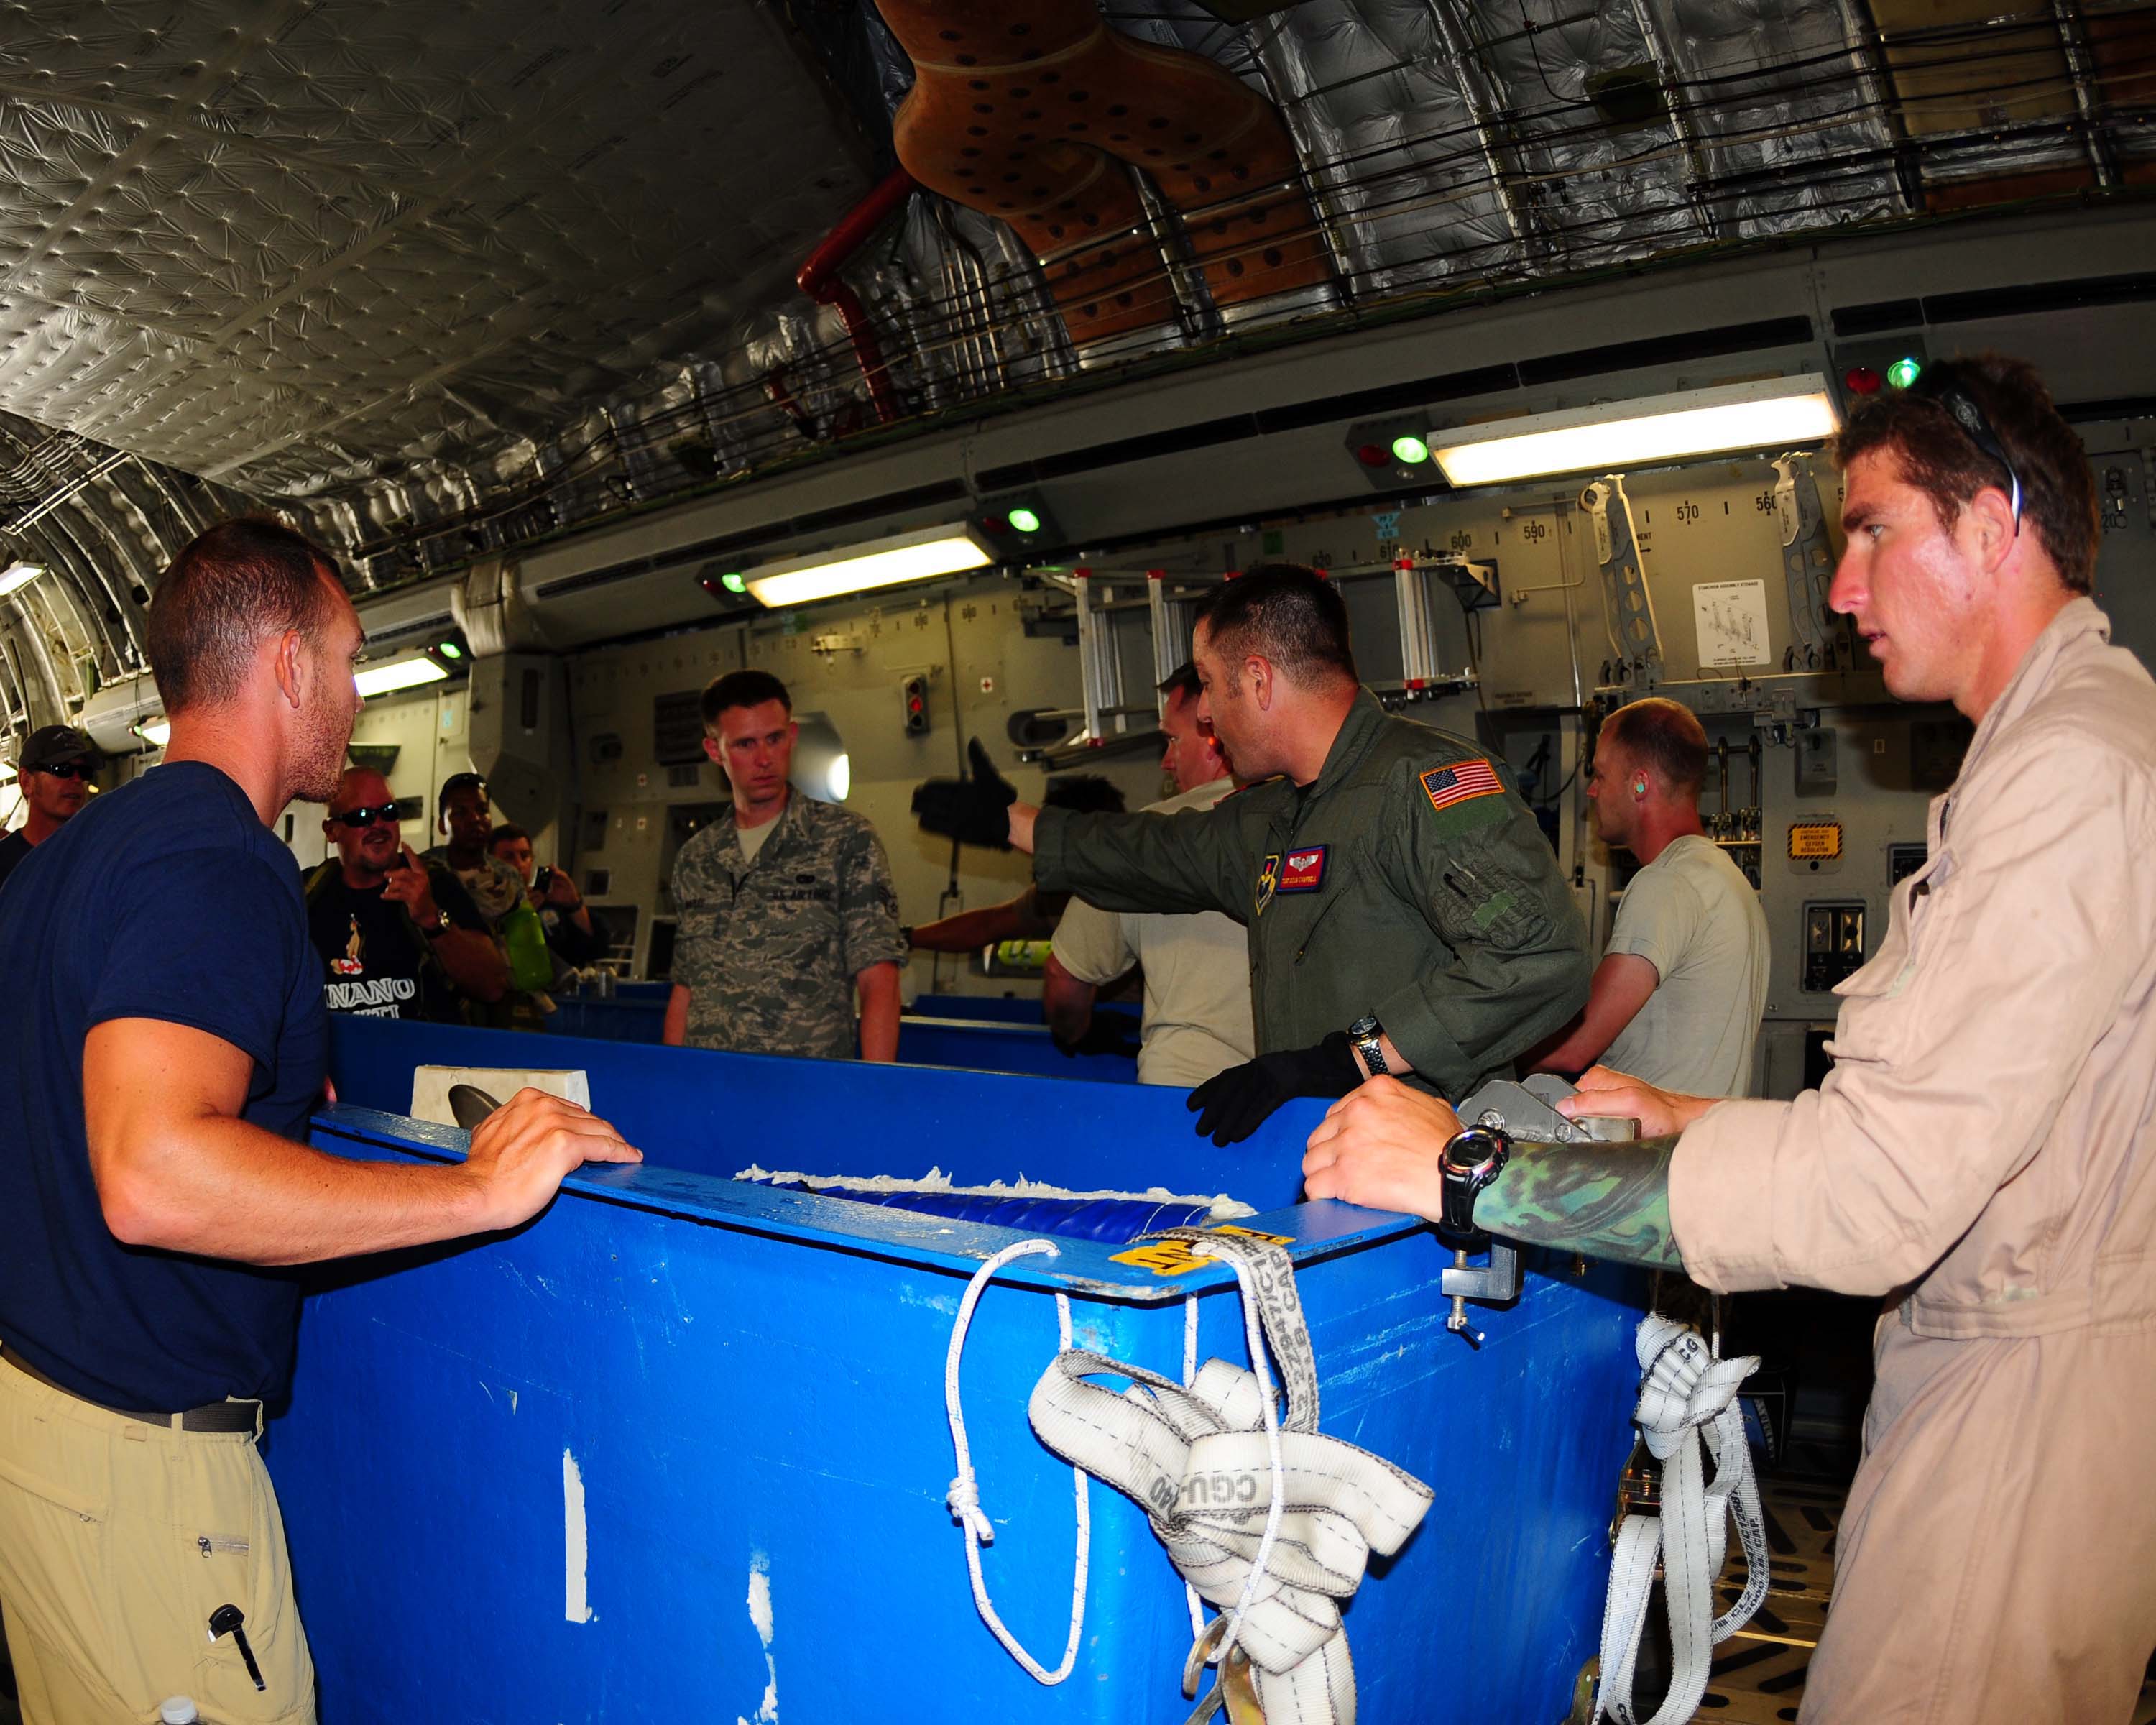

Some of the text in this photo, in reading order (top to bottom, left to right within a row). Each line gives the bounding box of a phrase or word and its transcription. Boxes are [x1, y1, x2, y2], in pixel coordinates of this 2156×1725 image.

[1676, 504, 1699, 521] 570
[1524, 524, 1545, 540] 590
[1451, 534, 1472, 548] 600
[323, 978, 415, 1009] NANO
